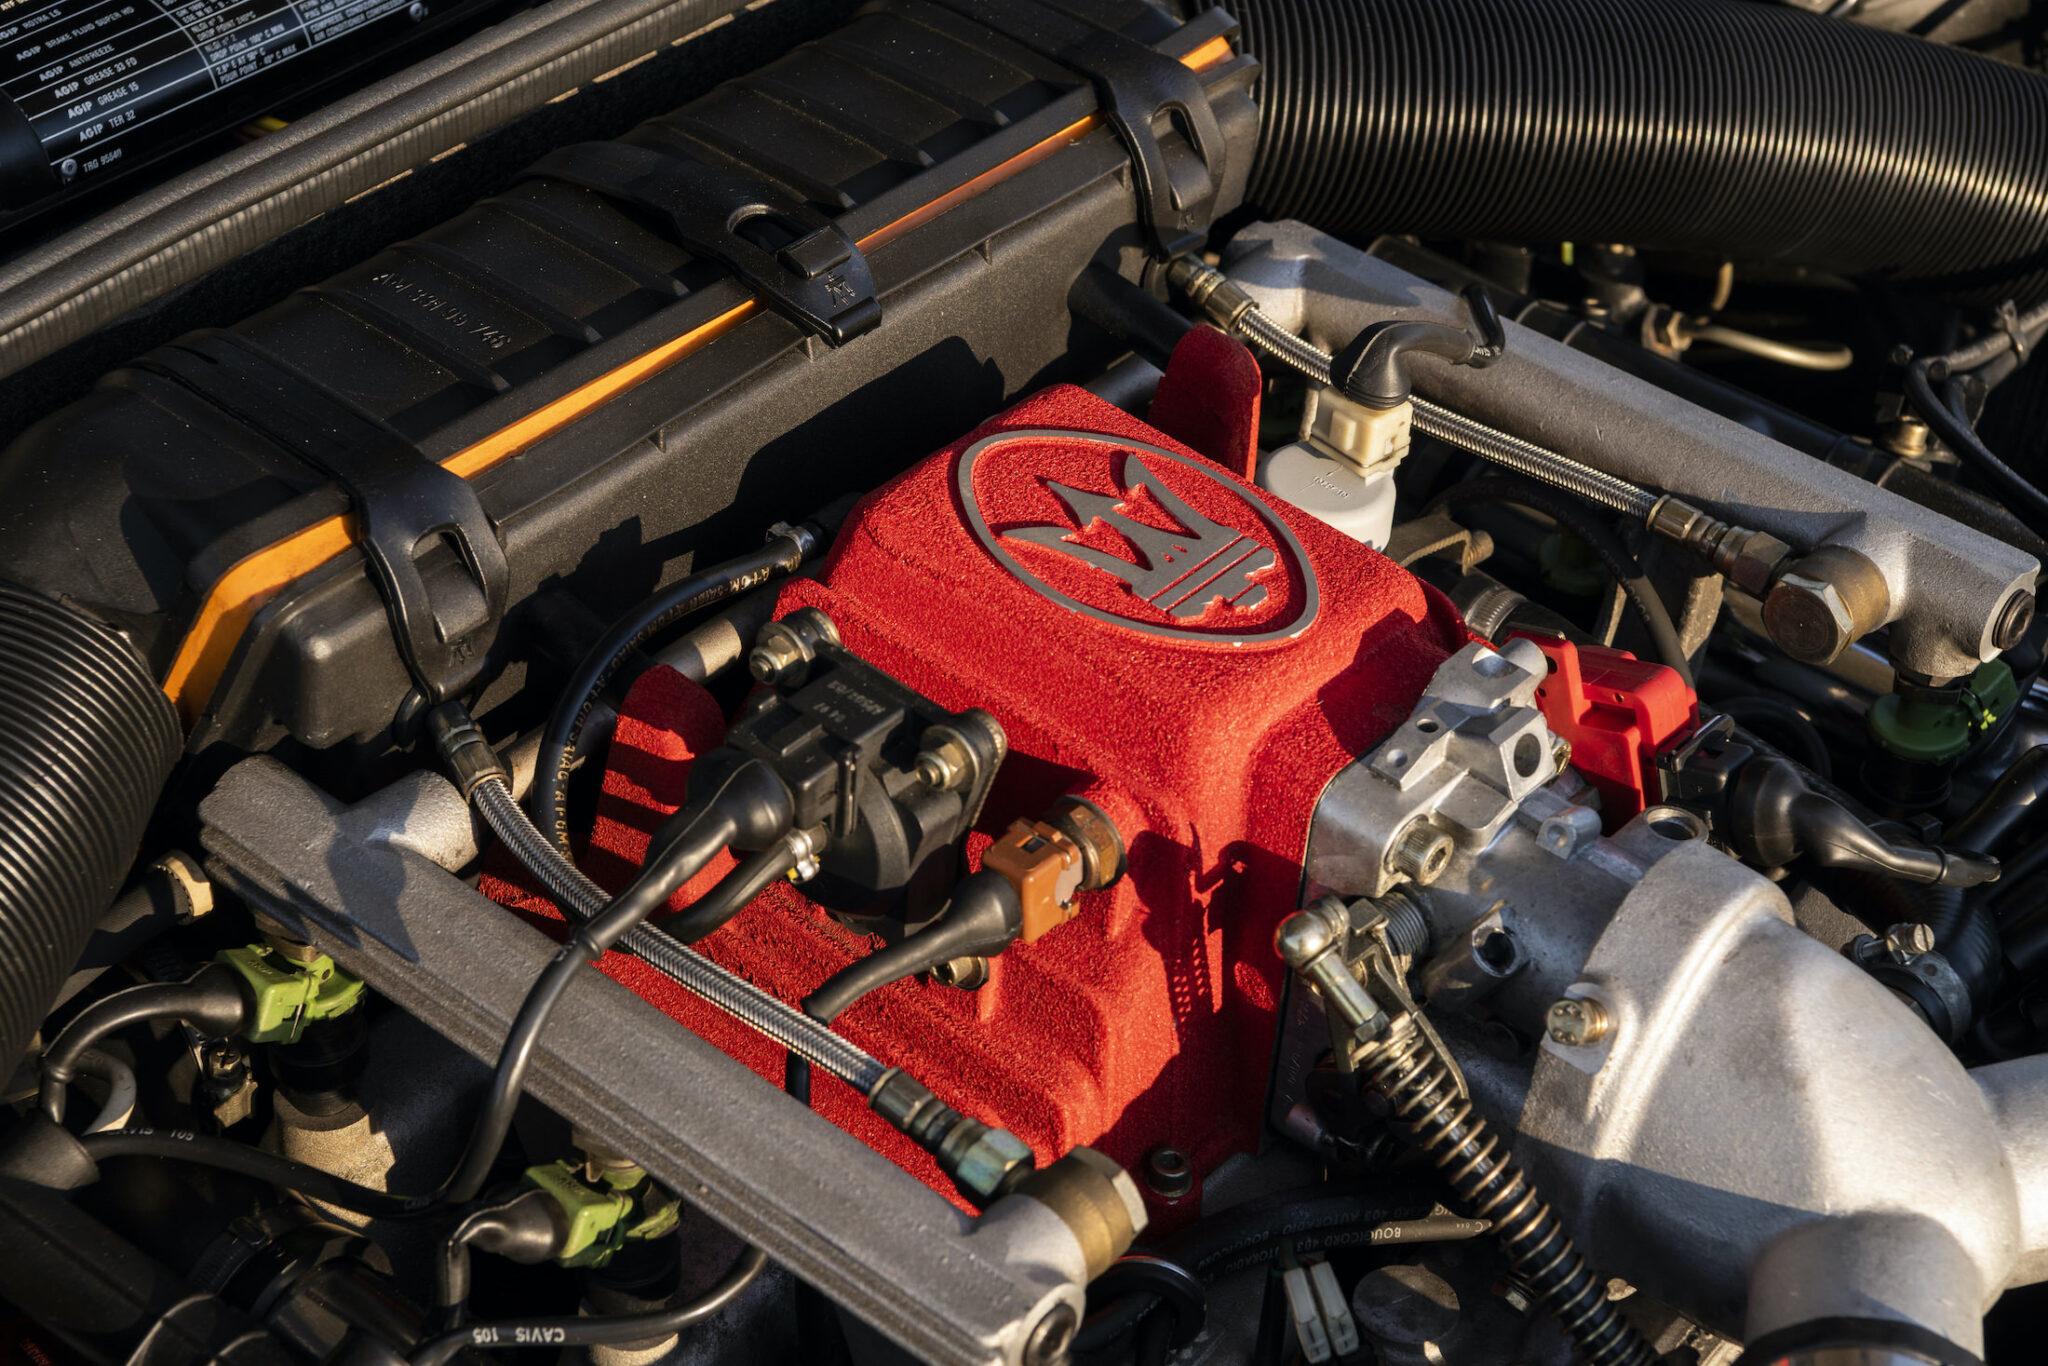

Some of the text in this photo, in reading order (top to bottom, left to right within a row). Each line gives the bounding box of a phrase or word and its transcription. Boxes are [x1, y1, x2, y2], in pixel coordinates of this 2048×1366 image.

[16, 45, 41, 61] AGIP
[45, 33, 73, 48] BRAKE
[72, 23, 95, 37] FLUID
[95, 12, 122, 26] SUPER
[39, 44, 115, 82] AGIP ANTIFREEZE
[54, 57, 138, 98] AGIP GREASE 33 FD
[67, 82, 140, 119] AGIP GREASE 15
[79, 109, 136, 142] AGIP TER 32
[472, 1326, 566, 1344] CAVIS 105
